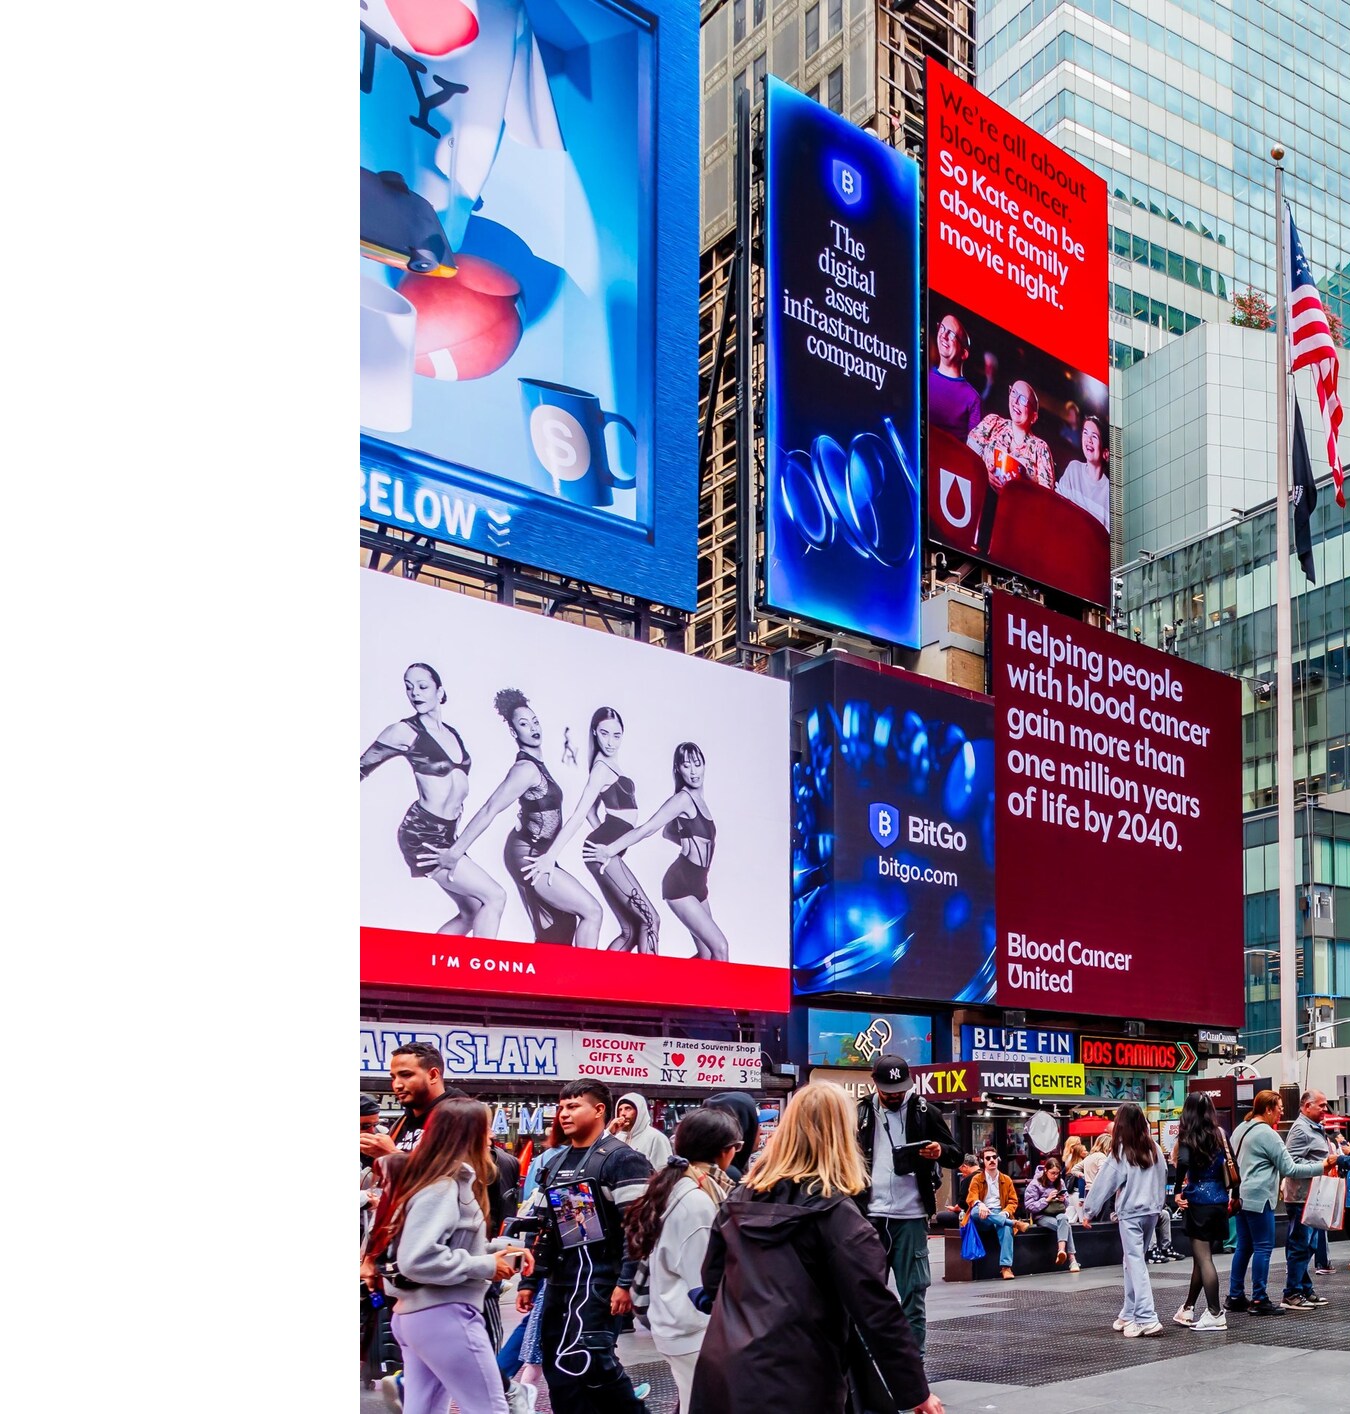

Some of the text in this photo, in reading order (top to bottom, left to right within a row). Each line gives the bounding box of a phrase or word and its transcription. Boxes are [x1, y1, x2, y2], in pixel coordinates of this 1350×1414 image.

[940, 83, 1087, 203] We're all about
[940, 115, 1072, 223] blood cancer.
[939, 150, 1085, 262] So Kate can be
[830, 219, 866, 261] The
[939, 189, 1068, 285] about family
[818, 247, 876, 297] digital
[939, 221, 1064, 310] movie night.
[825, 286, 870, 324] asset
[783, 288, 908, 370] infrastructure
[806, 334, 887, 391] company
[1007, 613, 1183, 702] Helping people
[1006, 662, 1210, 748] with blood cancer
[1007, 706, 1185, 778] gain more than
[1007, 749, 1200, 819] one million years
[908, 815, 967, 852] BitGo
[1007, 786, 1183, 852] of life by 2040.
[878, 855, 958, 888] bitgo.com
[431, 954, 536, 975] I'M GONNA
[1007, 931, 1132, 971] Blood Cancer
[1007, 963, 1073, 994] United
[447, 1030, 557, 1075] SLAM
[582, 1038, 646, 1052] DISCOUNT
[589, 1051, 635, 1064] GIFTS &
[663, 1040, 673, 1048] #1
[676, 1041, 699, 1050] Rated
[701, 1042, 734, 1052] Souvenir
[736, 1045, 756, 1054] Shop
[974, 1027, 1070, 1053] BLUE FIN
[974, 1051, 1070, 1064] SEAFOOD SUSHI
[1083, 1040, 1112, 1065] DOS
[578, 1064, 649, 1078] SOUVENIRS
[660, 1068, 687, 1083] NY
[696, 1054, 726, 1069] 99¢
[697, 1072, 726, 1084] Dept.
[739, 1069, 748, 1083] 3
[980, 1072, 1082, 1089] TICKET CENTER
